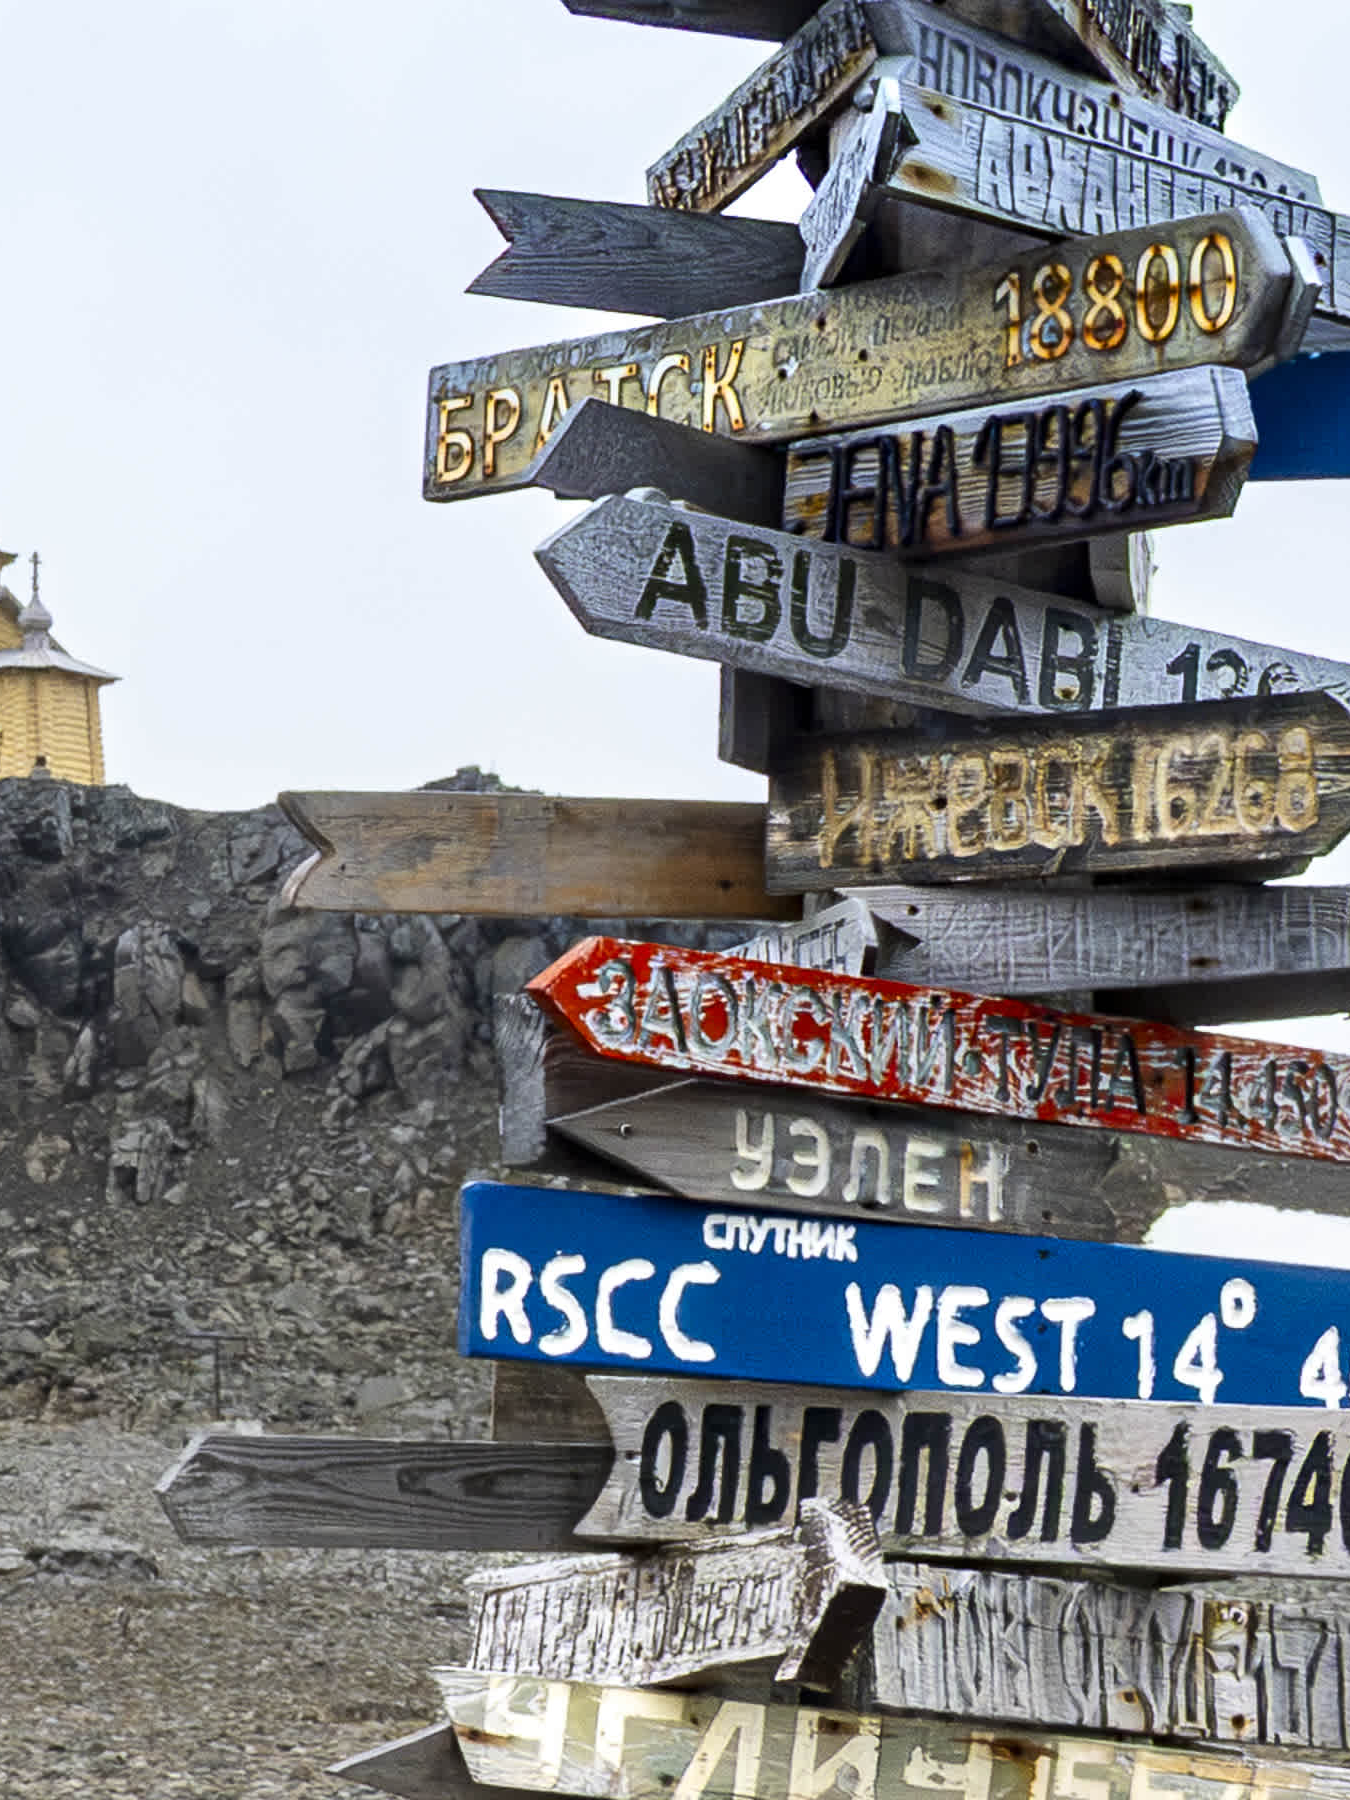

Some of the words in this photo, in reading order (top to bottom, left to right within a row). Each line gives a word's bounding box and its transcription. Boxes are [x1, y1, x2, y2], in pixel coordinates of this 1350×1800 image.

[435, 339, 748, 485] БРАТСК
[993, 231, 1239, 367] 18800
[634, 519, 857, 661] ABU
[900, 573, 1124, 713] DABI
[702, 1213, 859, 1263] СПУТНИК
[730, 1107, 1011, 1223] УЭЛЕН
[479, 1248, 721, 1363] RSCC
[846, 1280, 1096, 1395] WEST
[639, 1399, 1117, 1545] ОЛЬГОПОЛЬ
